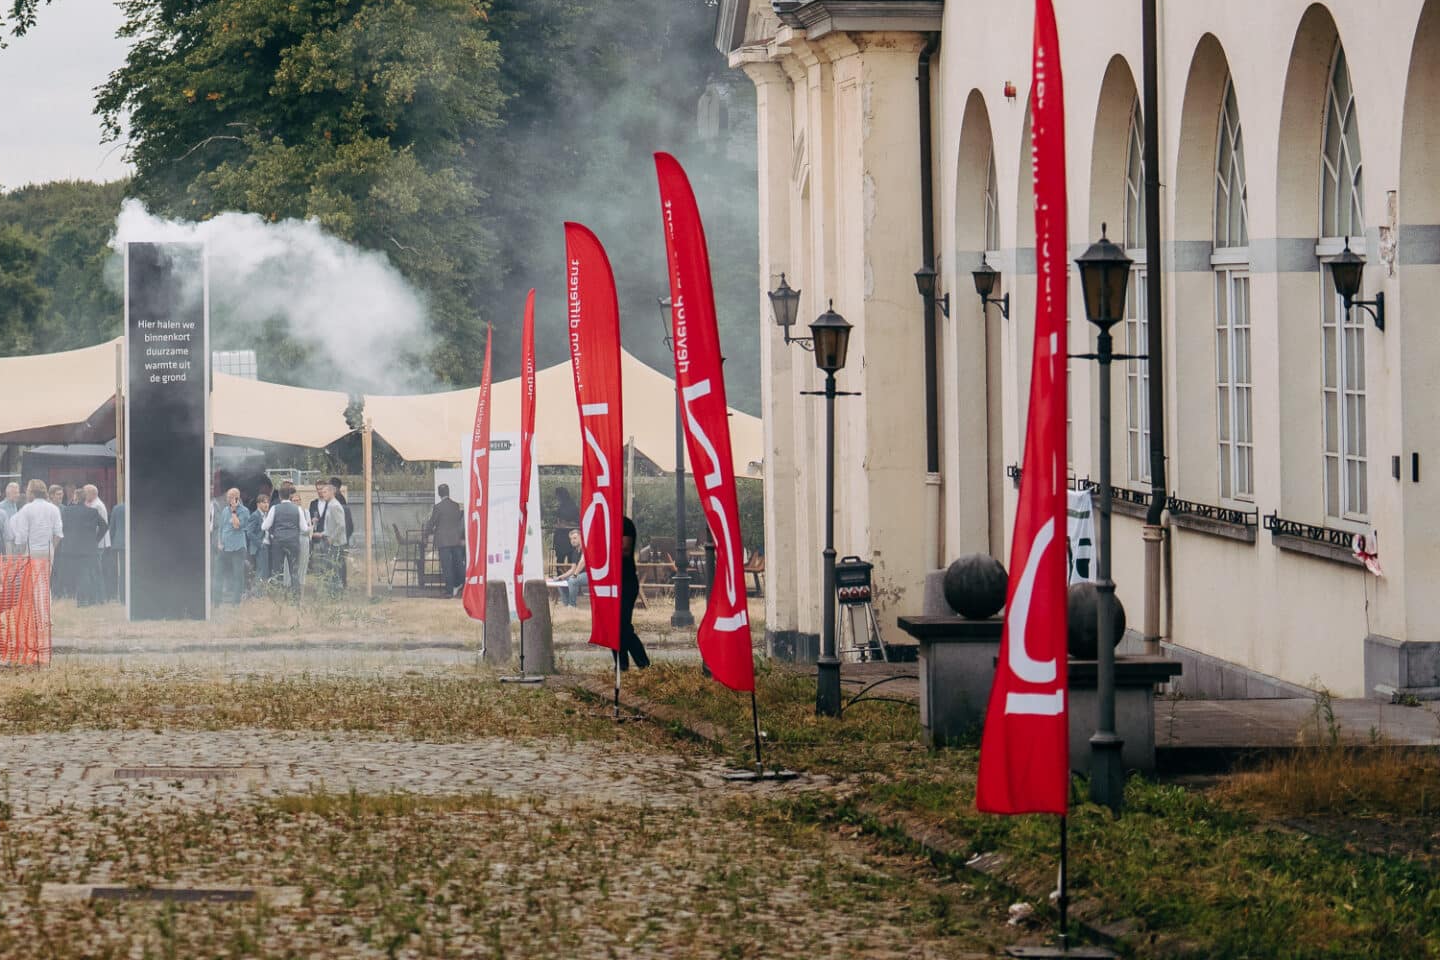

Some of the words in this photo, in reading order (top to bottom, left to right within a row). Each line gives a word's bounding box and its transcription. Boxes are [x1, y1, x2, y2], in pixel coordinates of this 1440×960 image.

[138, 320, 155, 329] Hier
[157, 320, 181, 329] halen
[144, 333, 190, 342] binnenkort
[146, 347, 189, 356] duurzame
[144, 361, 178, 370] warmte
[179, 360, 191, 369] uit
[150, 374, 161, 382] de
[162, 373, 187, 384] grond
